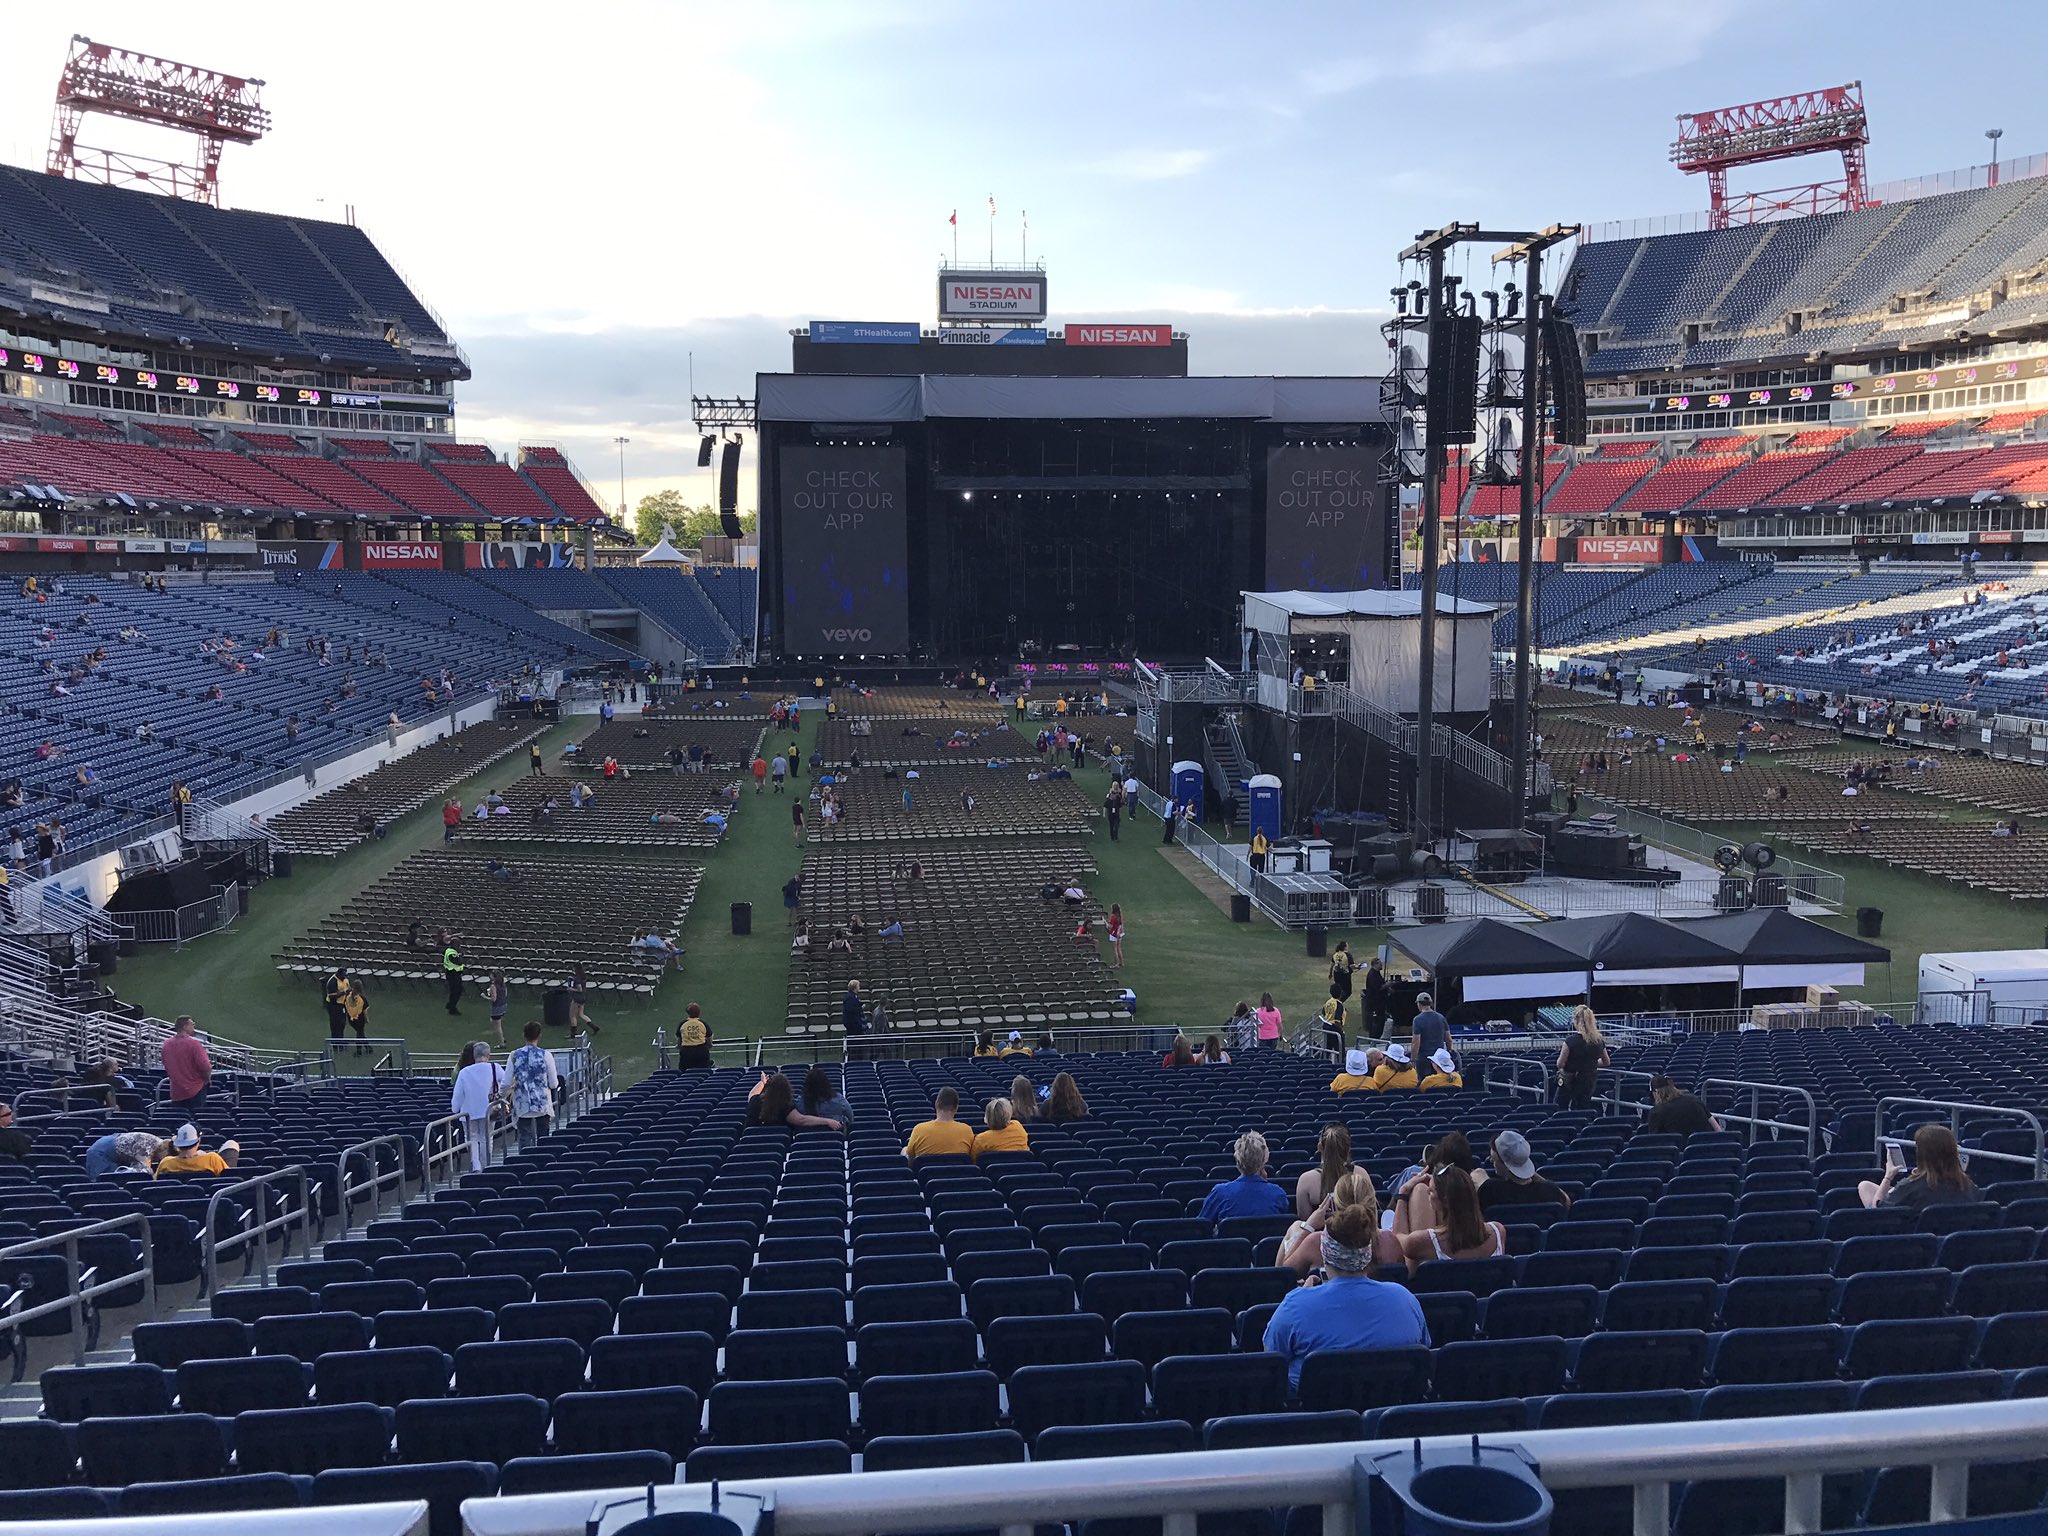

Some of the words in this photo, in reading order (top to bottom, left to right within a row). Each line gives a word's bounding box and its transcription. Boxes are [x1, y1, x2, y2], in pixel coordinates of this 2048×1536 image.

[954, 287, 1032, 300] NISSAN
[853, 328, 912, 337] STHealth.com
[940, 331, 991, 343] Pinnacle
[1080, 329, 1157, 342] NISSAN
[1956, 368, 1977, 379] CMA
[1996, 363, 2017, 374] CMA
[1874, 378, 1896, 388] CMA
[1916, 373, 1938, 384] CMA
[256, 386, 279, 396] CMA
[1790, 387, 1812, 397] CMA
[1832, 383, 1853, 392] CMA
[298, 390, 320, 400] CMA
[1708, 394, 1730, 404] CMA
[1749, 390, 1770, 400] CMA
[1667, 396, 1689, 406] CMA
[806, 471, 880, 488] CHECK
[1291, 470, 1362, 487] CHECK
[793, 491, 840, 509] OUT
[847, 491, 893, 509] OUR
[1279, 491, 1323, 507] OUT
[1329, 490, 1374, 507] OUR
[823, 513, 864, 529] APP
[1306, 511, 1345, 527] APP
[52, 541, 73, 549] NISSAN
[1583, 540, 1658, 552] NISSAN
[366, 546, 438, 559] NISSAN
[822, 628, 872, 642] vevo
[1014, 663, 1037, 672] CMA
[1046, 663, 1068, 672] CMA
[1077, 663, 1099, 671] CMA
[1108, 662, 1131, 671] CMA
